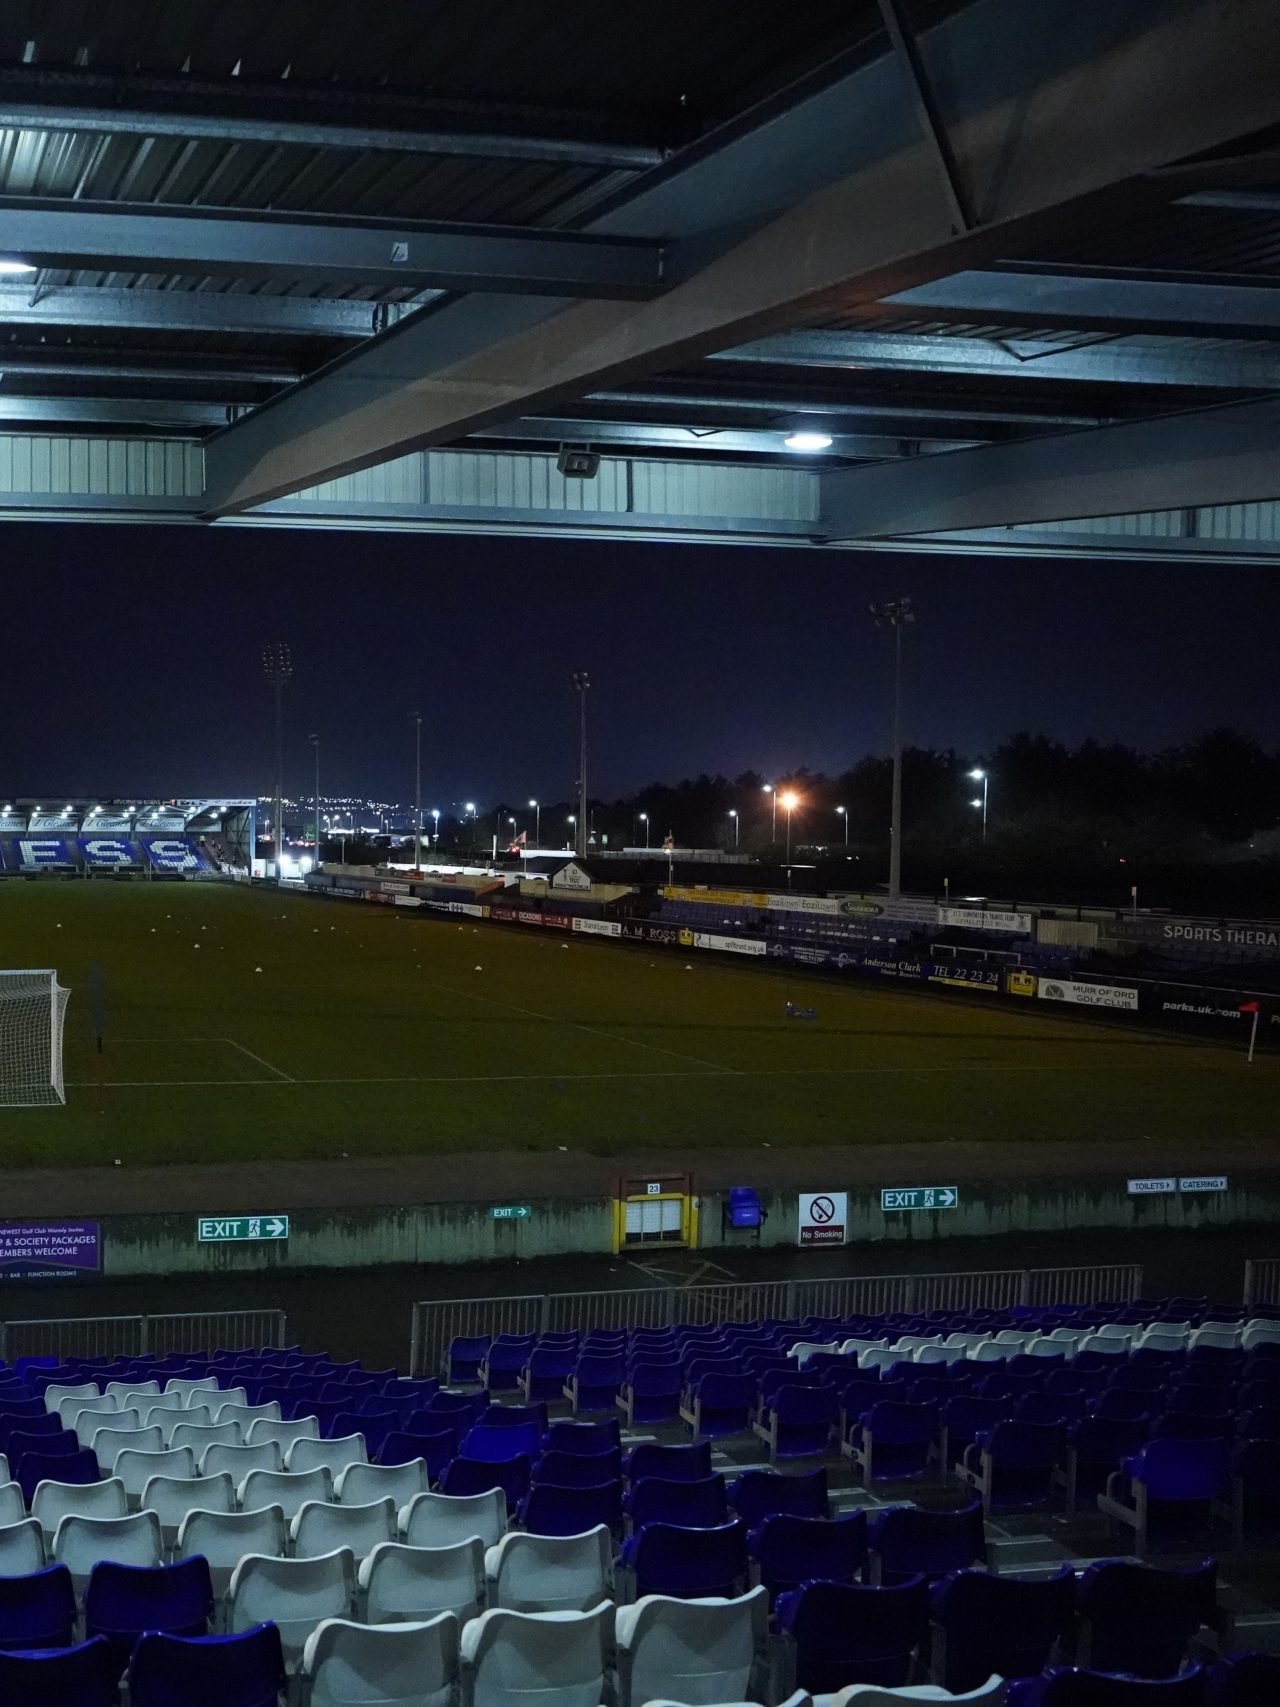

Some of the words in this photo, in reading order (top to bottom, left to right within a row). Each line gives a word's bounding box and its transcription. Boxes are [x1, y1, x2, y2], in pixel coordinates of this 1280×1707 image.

[650, 928, 676, 942] ROSS
[1164, 925, 1222, 942] SPORTS
[1225, 929, 1280, 946] THERA
[863, 957, 897, 969] Anderson
[898, 961, 921, 973] Clark
[933, 965, 950, 977] TEL
[953, 968, 966, 979] 22
[969, 970, 983, 981] 23
[985, 972, 999, 983] 24
[1073, 985, 1096, 996] MUIR
[1098, 987, 1112, 997] OF
[1114, 990, 1136, 1001] ORD
[1076, 995, 1103, 1005] GOLF
[1104, 998, 1131, 1008] CLUB
[1162, 1002, 1241, 1018] parks.uk.com
[649, 1185, 659, 1193] 23
[1135, 1182, 1165, 1190] TOILETS
[1182, 1181, 1219, 1189] CATERING
[885, 1192, 918, 1206] EXIT
[494, 1208, 513, 1217] EXIT
[202, 1221, 241, 1237] EXIT
[802, 1231, 812, 1240] No
[814, 1230, 843, 1240] Smoking
[5, 1238, 12, 1247] &
[13, 1237, 49, 1247] SOCIETY
[51, 1235, 96, 1245] PACKAGES
[33, 1246, 78, 1256] WELCOME
